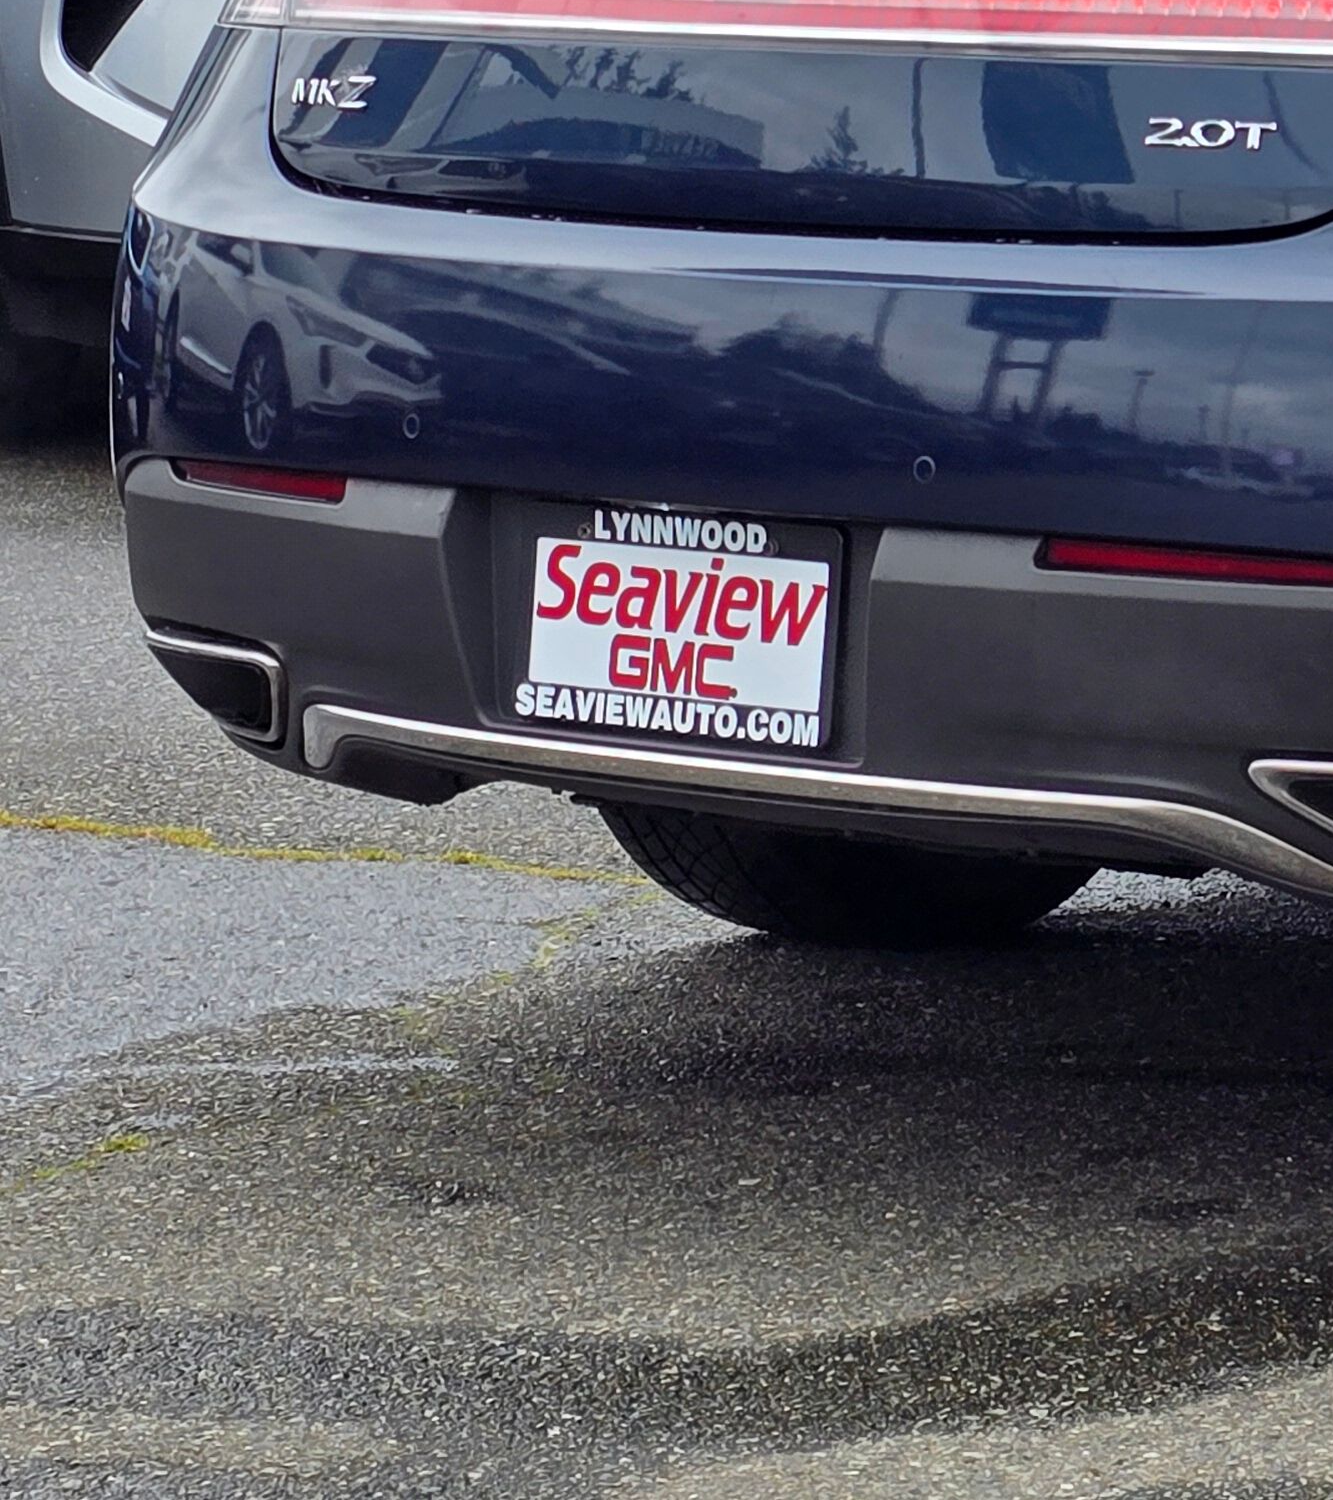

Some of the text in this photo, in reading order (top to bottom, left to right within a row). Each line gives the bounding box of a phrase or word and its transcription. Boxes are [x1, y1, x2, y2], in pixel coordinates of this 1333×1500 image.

[291, 75, 377, 108] MKZ
[1144, 117, 1278, 150] 2.0T
[594, 509, 768, 554] LYNNWOOD
[536, 544, 829, 647] Seaview
[608, 633, 737, 701] GMC
[515, 683, 820, 747] SEAVIEWAUTO.COM
